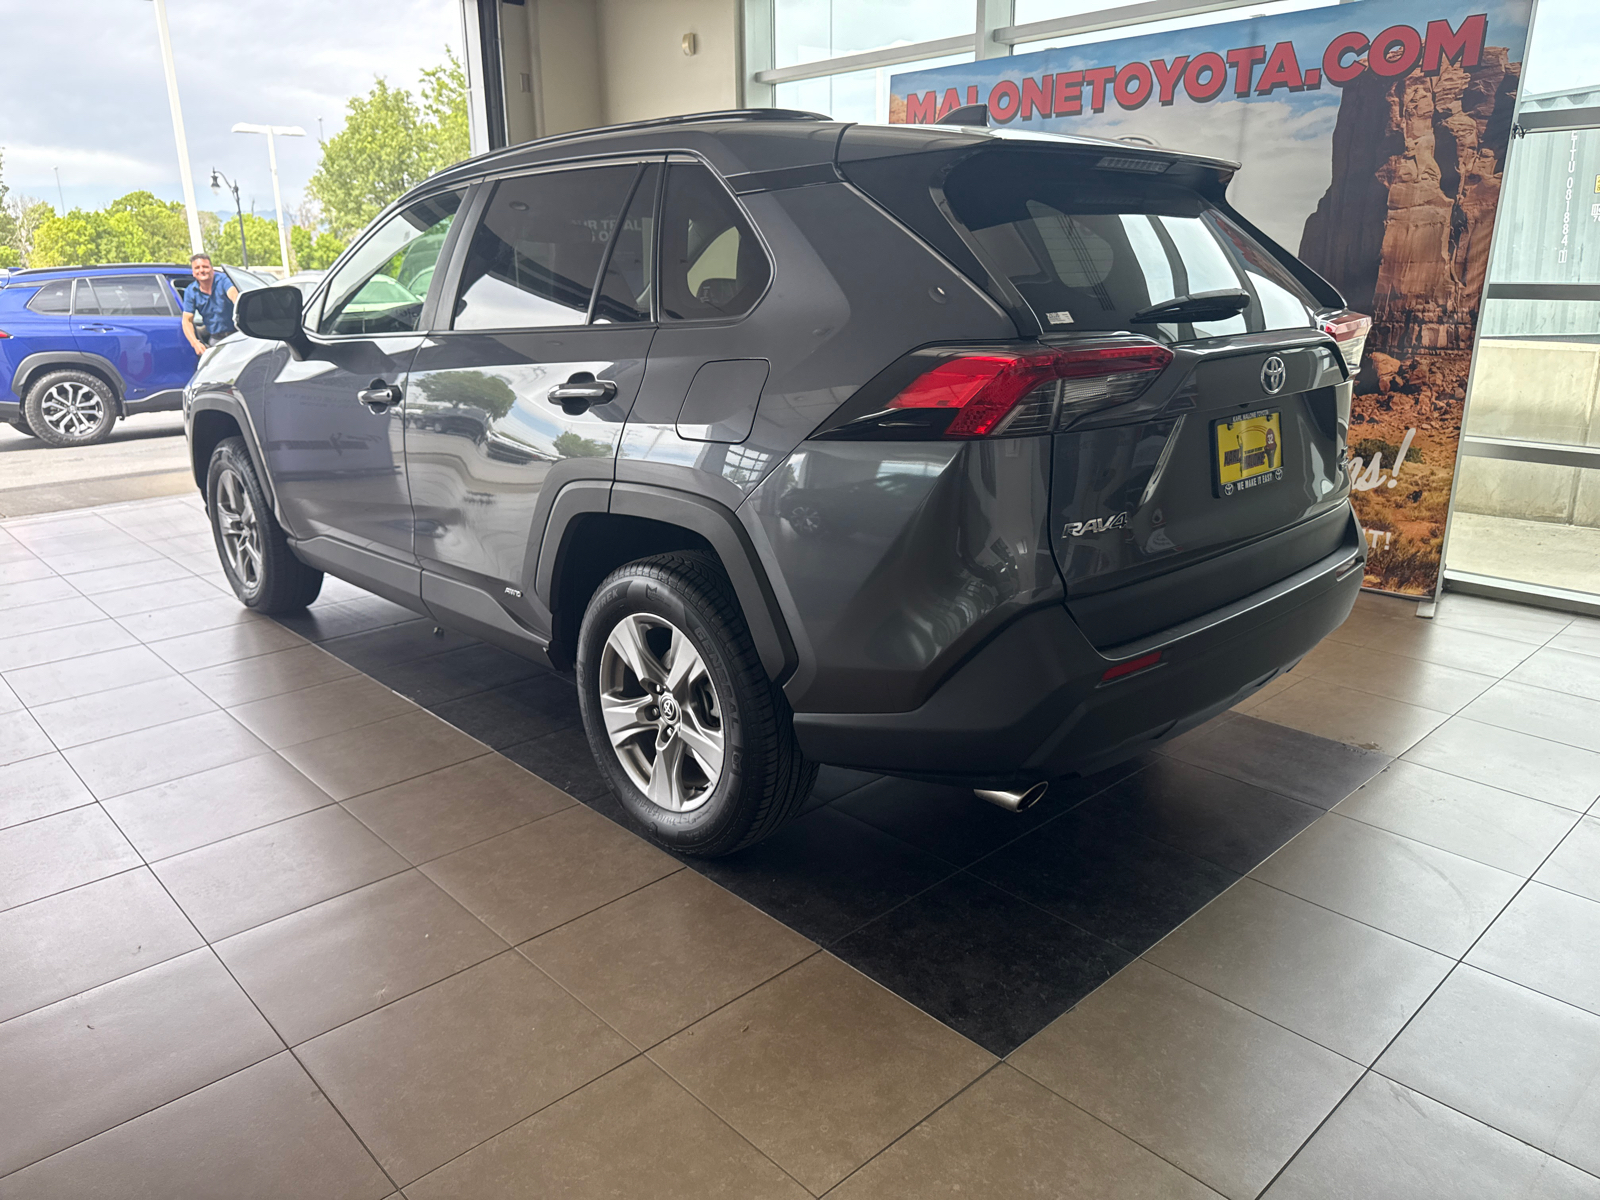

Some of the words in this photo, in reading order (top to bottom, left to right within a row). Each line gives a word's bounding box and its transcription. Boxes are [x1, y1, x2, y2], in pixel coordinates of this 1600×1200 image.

[1560, 177, 1574, 246] 081884
[1237, 481, 1245, 491] WE
[1061, 511, 1127, 539] RAV4
